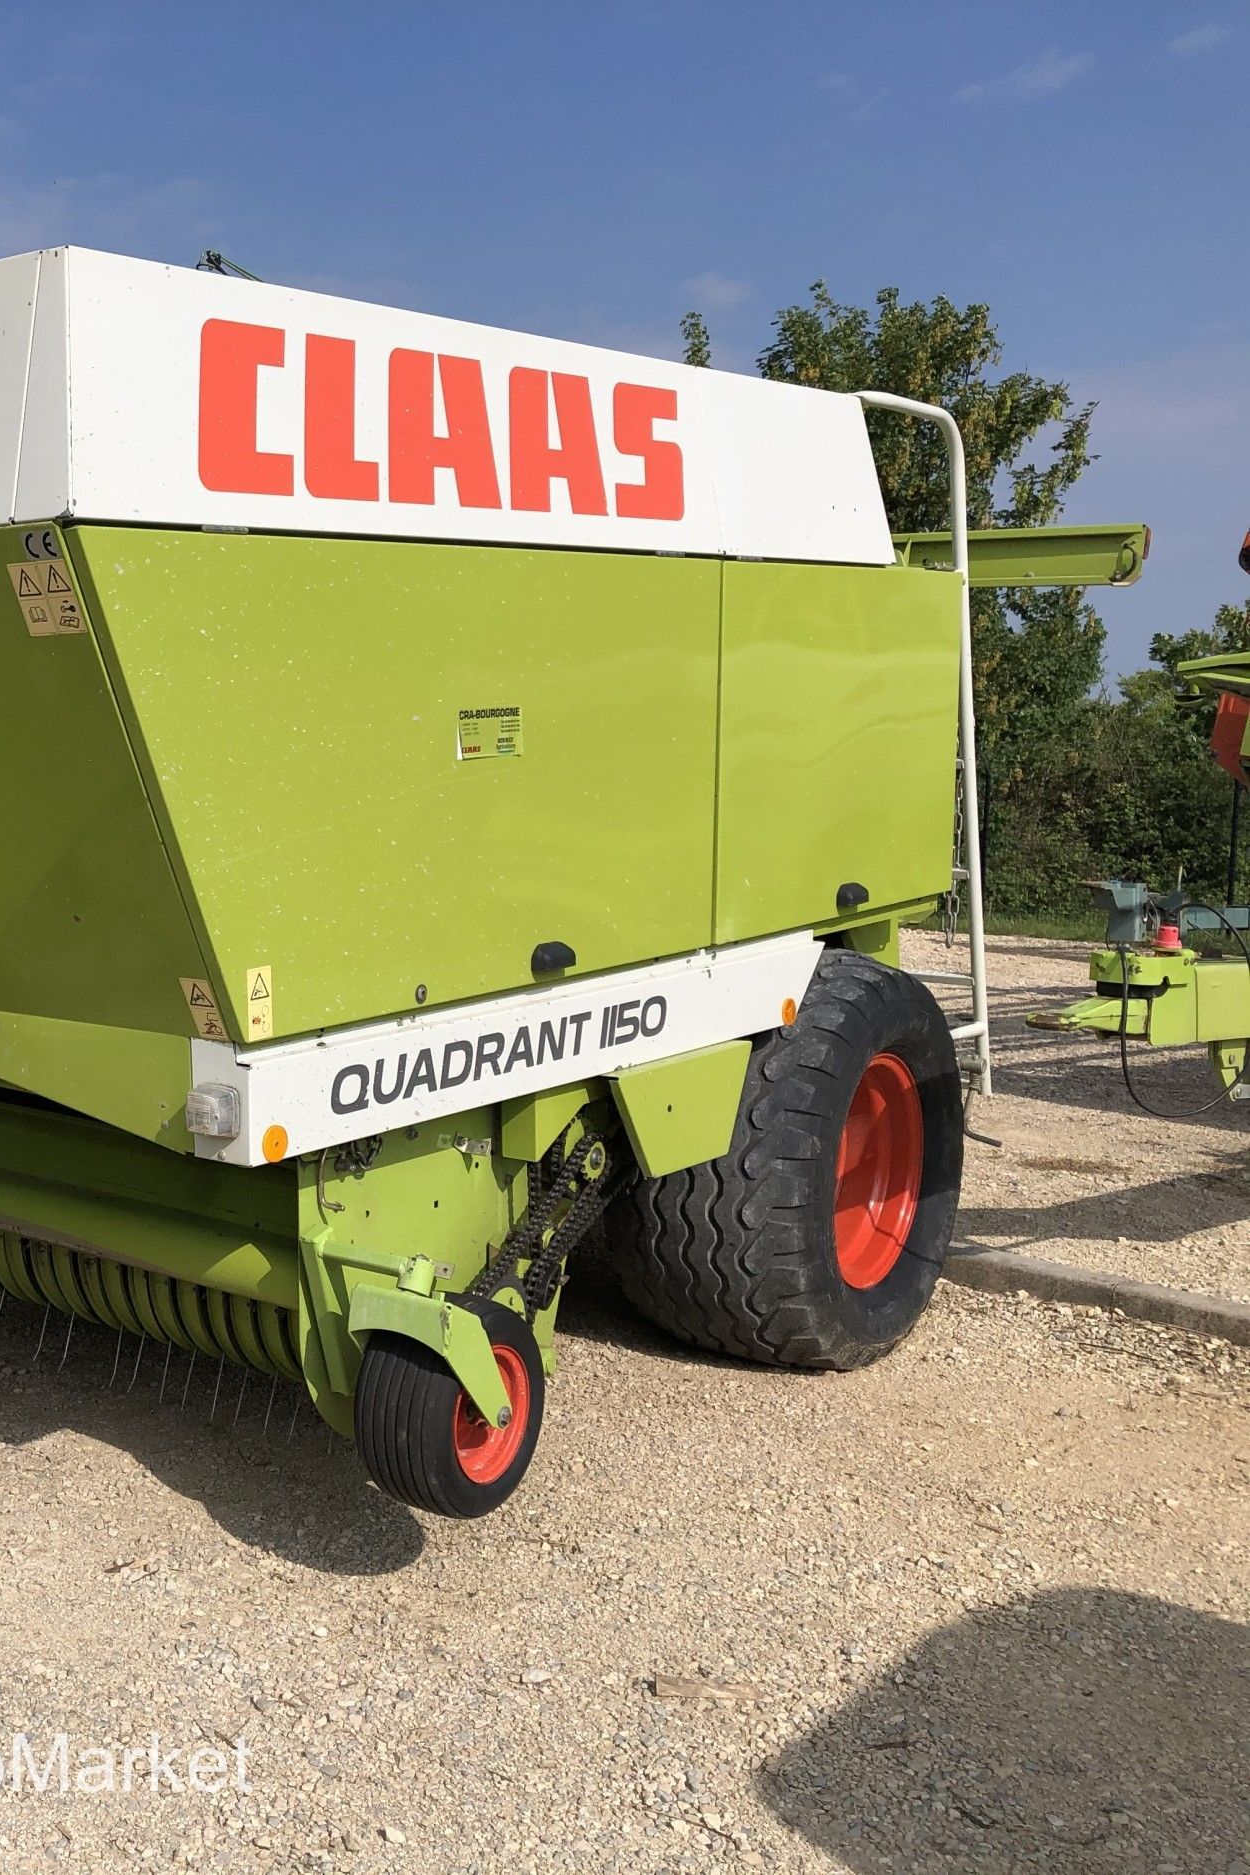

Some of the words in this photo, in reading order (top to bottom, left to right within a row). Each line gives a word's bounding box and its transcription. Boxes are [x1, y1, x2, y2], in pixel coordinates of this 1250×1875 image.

[198, 318, 685, 521] CLAAS
[25, 531, 57, 559] CE
[459, 707, 520, 720] CRA-BOURGOGNE
[330, 1011, 592, 1116] QUADRANT
[599, 995, 667, 1049] 1150
